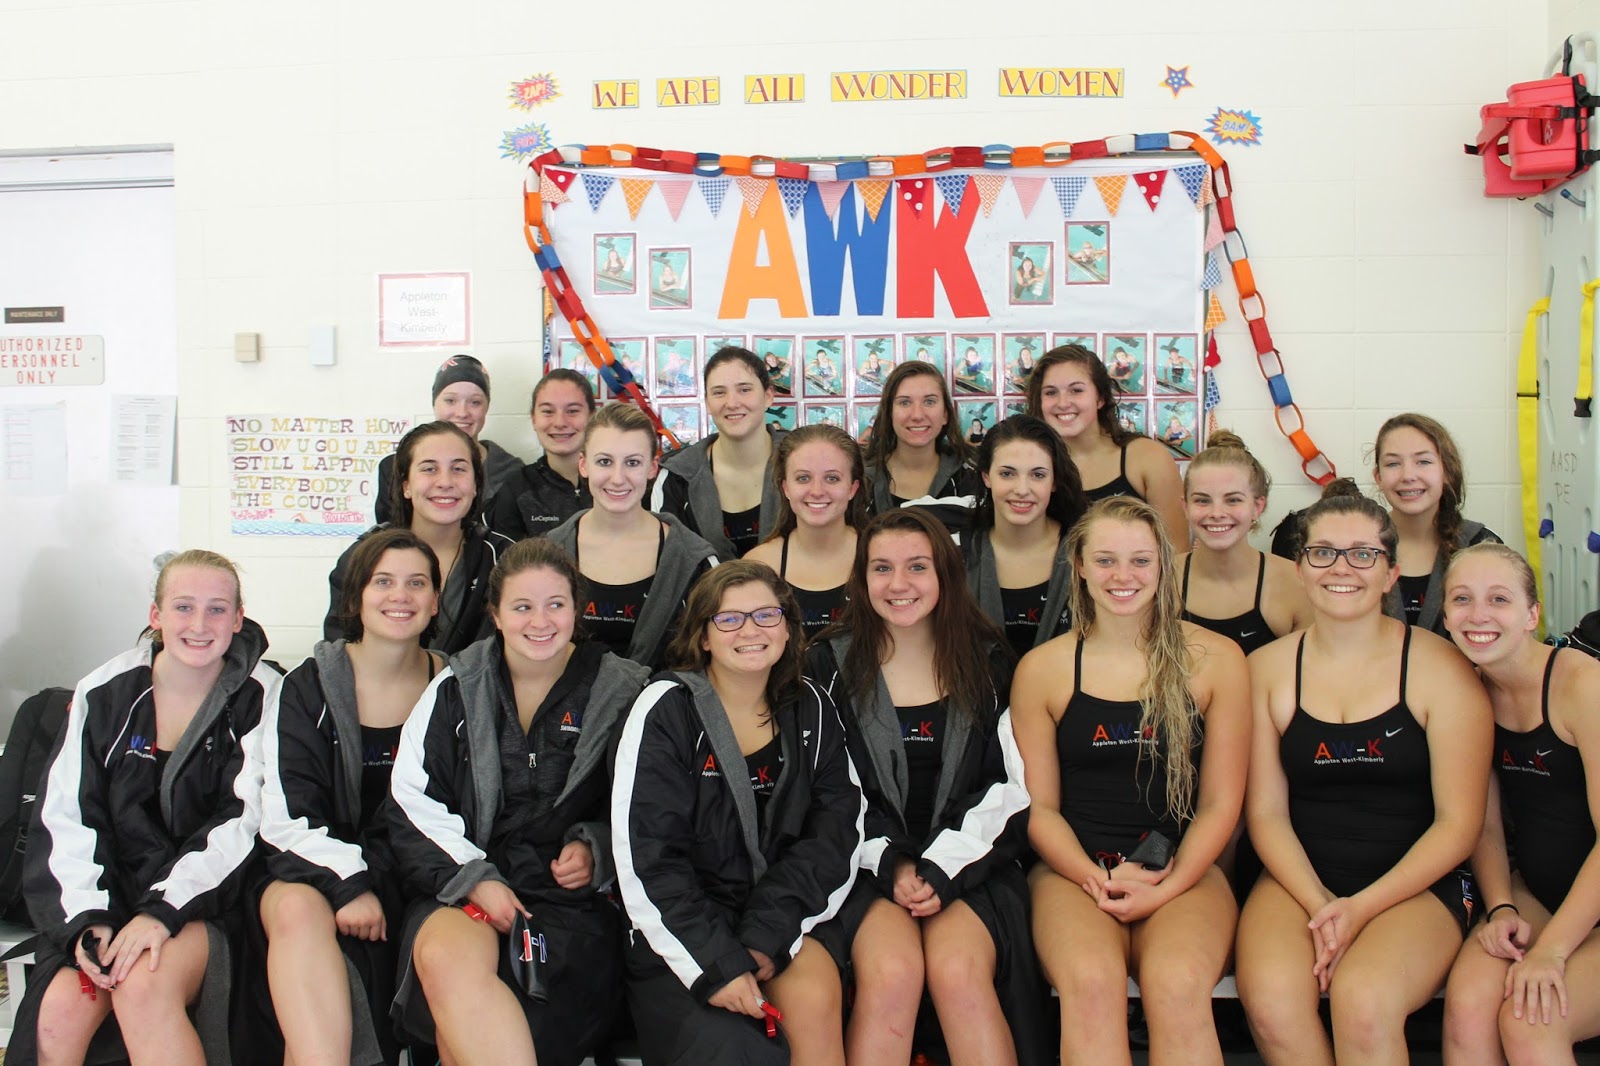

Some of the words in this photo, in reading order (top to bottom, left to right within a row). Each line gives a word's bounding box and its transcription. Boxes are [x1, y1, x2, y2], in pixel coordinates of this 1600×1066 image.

[524, 82, 546, 100] ZAP!
[594, 80, 638, 107] WE
[659, 77, 719, 105] ARE
[747, 75, 803, 102] ALL
[834, 72, 963, 99] WONDER
[1001, 69, 1121, 96] WOMEN
[717, 176, 991, 319] AWK
[400, 291, 447, 304] Appleton
[400, 322, 447, 335] Kimberly
[17, 370, 56, 384] ONLY
[230, 419, 262, 432] NO
[272, 418, 353, 433] MATTER
[366, 419, 407, 434] HOW
[232, 438, 291, 452] SLOW
[297, 438, 310, 453] U
[315, 438, 339, 453] GO
[345, 439, 358, 454] U
[234, 456, 293, 470] STILL
[303, 456, 378, 472] LAPPIN
[1550, 450, 1577, 474] AASD
[237, 475, 352, 493] EVERYBODY
[233, 492, 273, 506] THE
[283, 494, 349, 511] COUCH
[1315, 738, 1383, 760] AW-K
